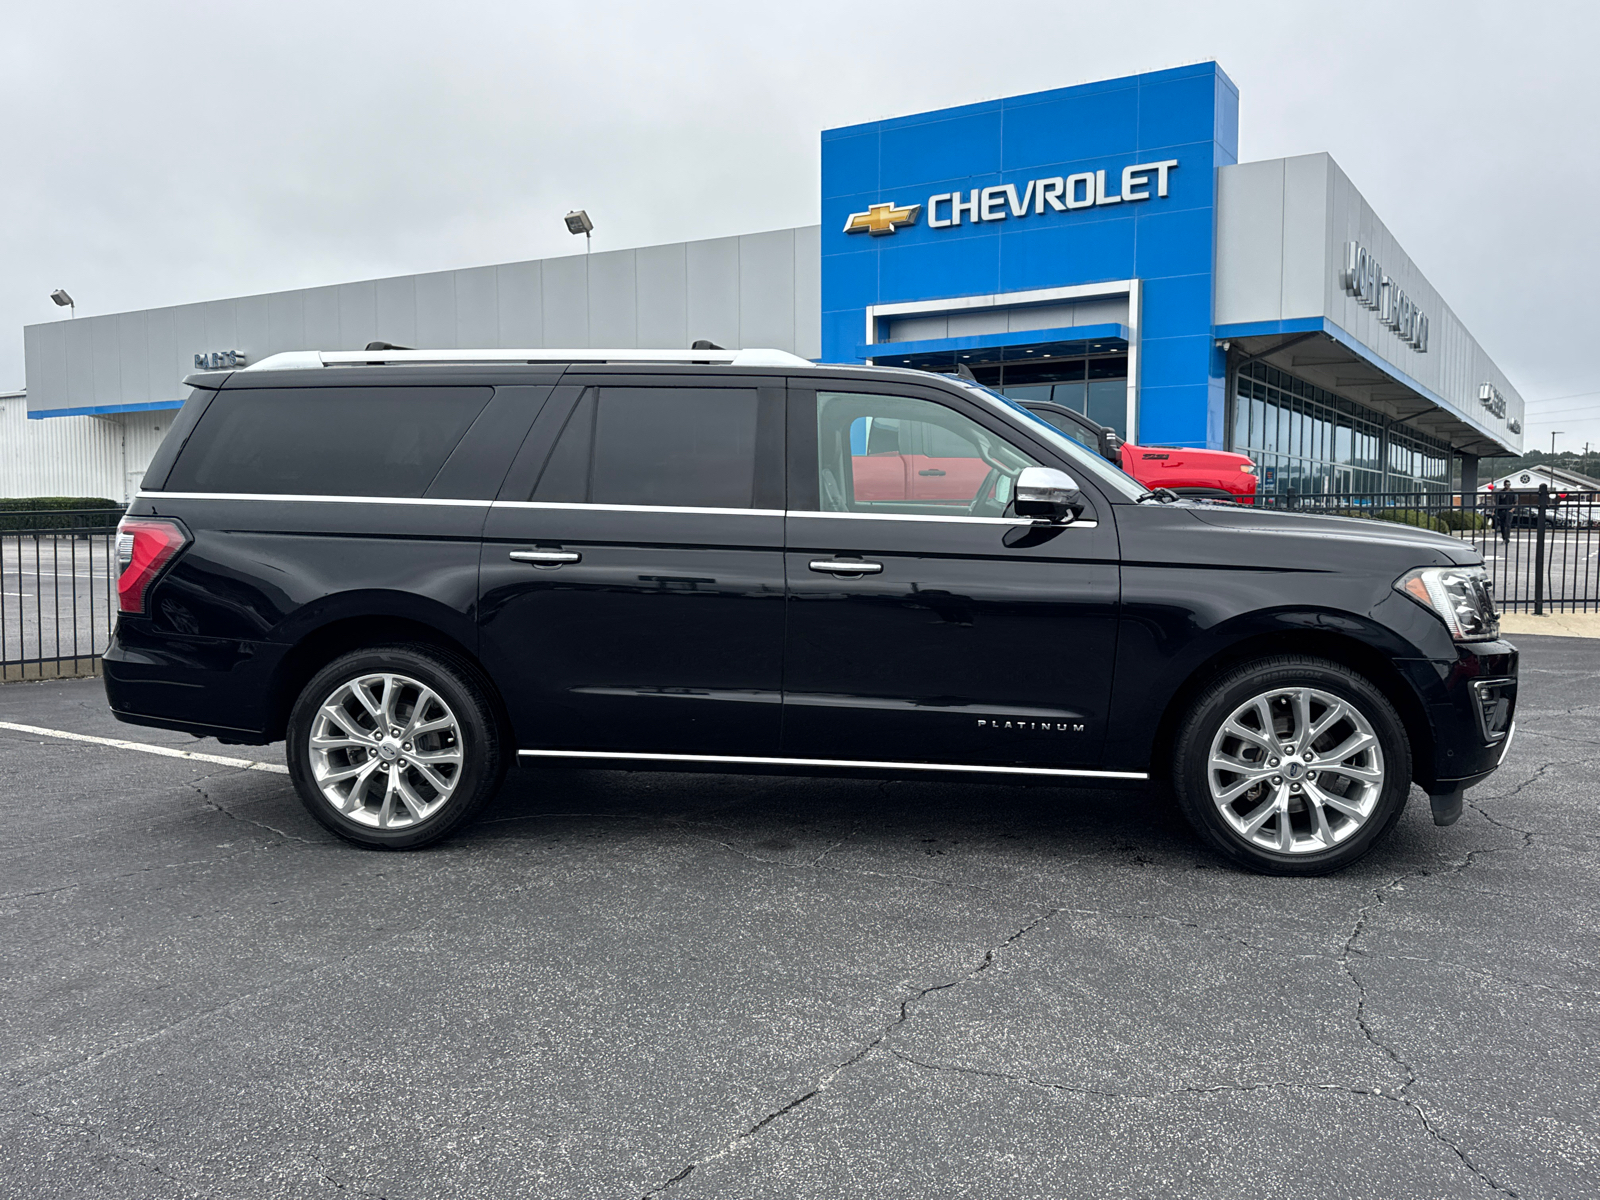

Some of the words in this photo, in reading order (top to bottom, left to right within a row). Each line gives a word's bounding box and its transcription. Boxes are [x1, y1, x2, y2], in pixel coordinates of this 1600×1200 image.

[928, 159, 1178, 228] CHEVROLET
[194, 350, 242, 370] PARTS
[977, 719, 1084, 732] PLATINUM
